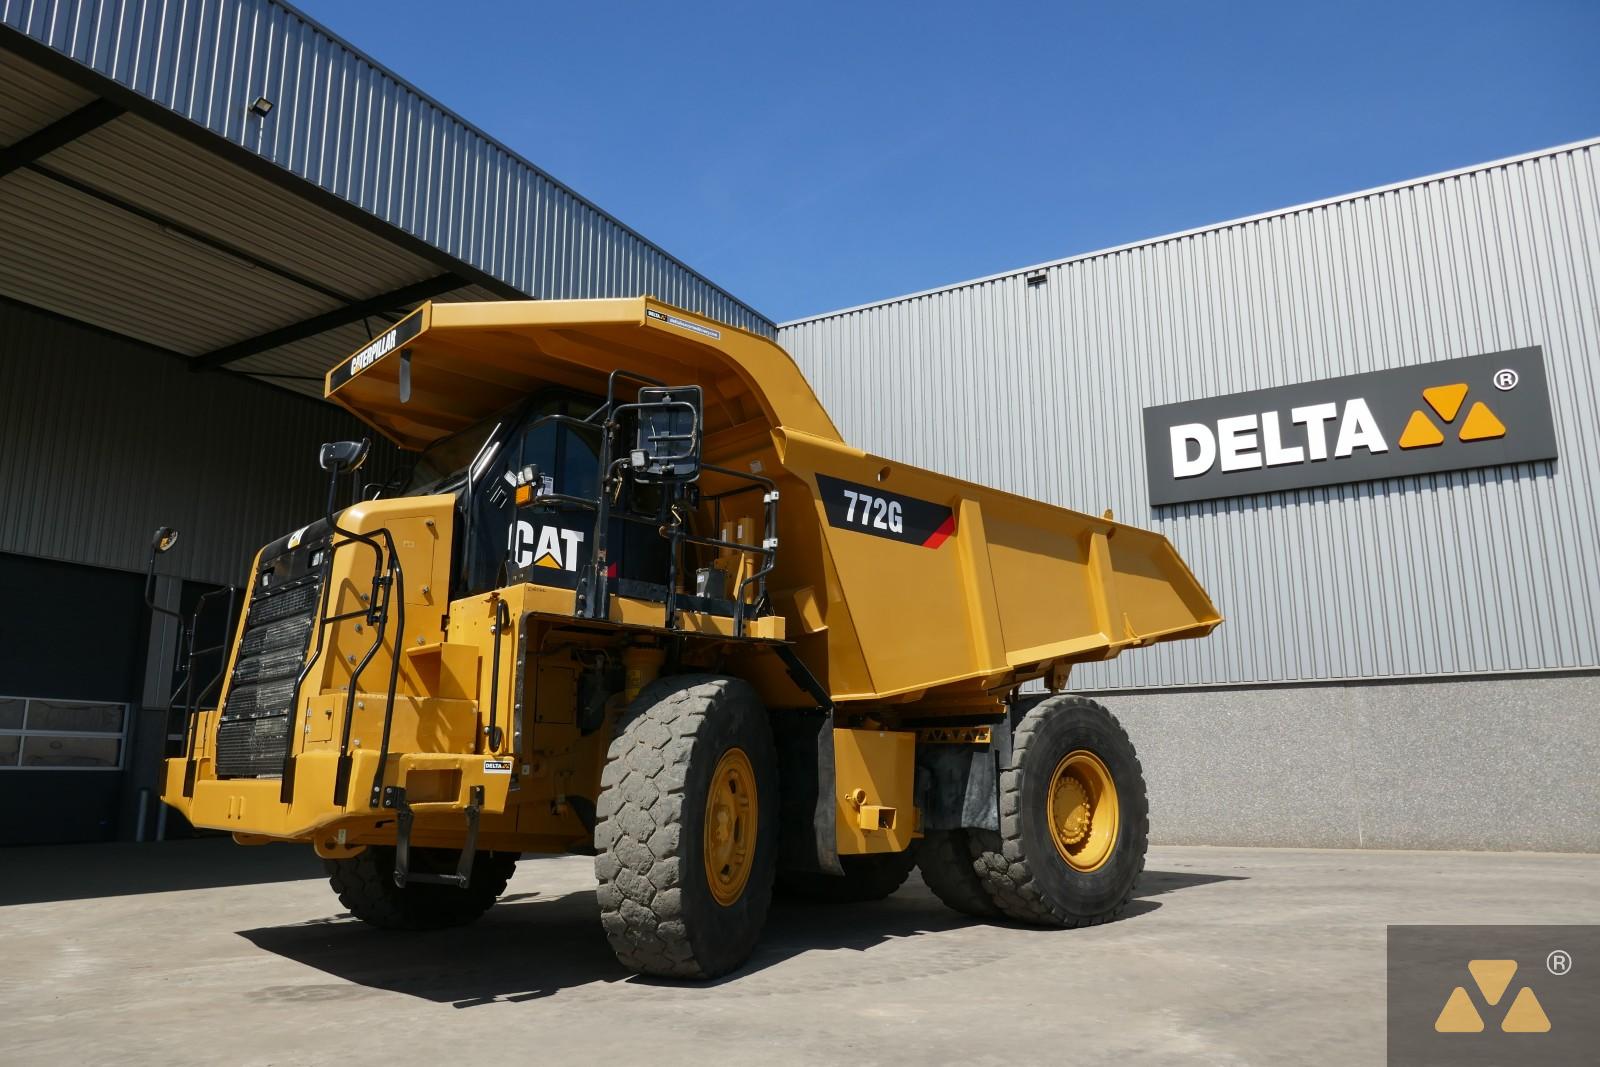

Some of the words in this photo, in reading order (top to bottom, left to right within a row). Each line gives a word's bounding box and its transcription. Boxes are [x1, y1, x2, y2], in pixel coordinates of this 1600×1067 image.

[350, 329, 397, 376] CATERPILLAR
[1169, 397, 1389, 480] DELTA
[843, 489, 903, 534] 772G
[507, 520, 585, 572] CAT
